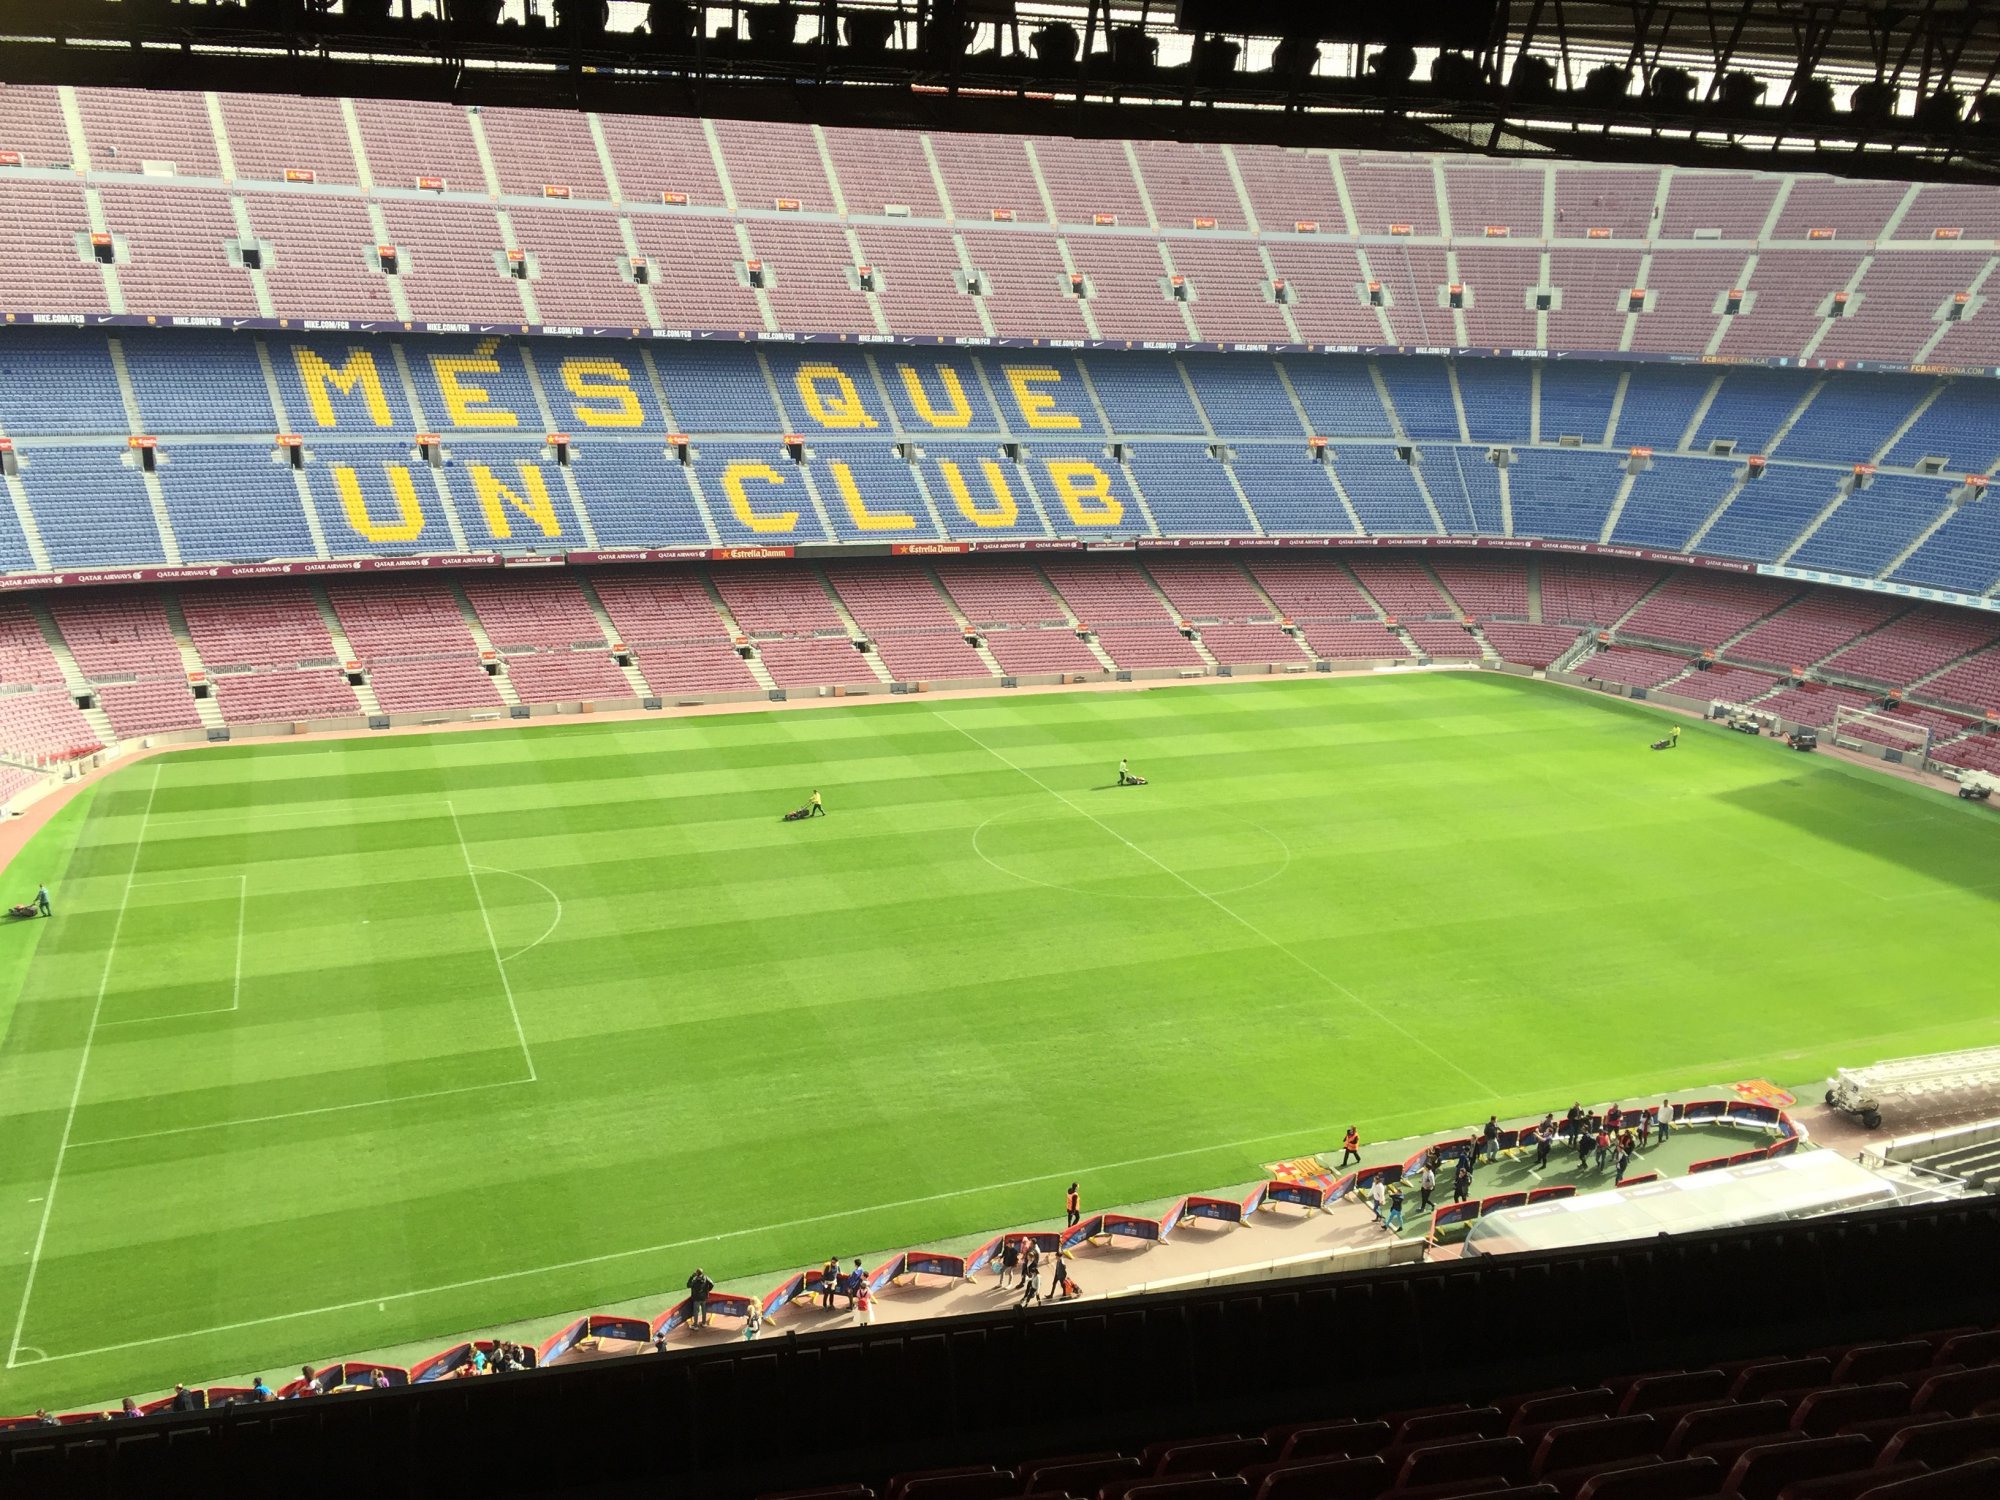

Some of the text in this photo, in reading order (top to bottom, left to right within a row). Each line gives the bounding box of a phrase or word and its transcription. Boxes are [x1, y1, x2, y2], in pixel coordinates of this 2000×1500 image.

[33, 314, 85, 324] NIKE.COM/FCB
[173, 316, 221, 326] NIKE.COM/FCB
[304, 320, 349, 330] NIKE.COM/FCB
[427, 323, 470, 332] NIKE.COM/FCB
[543, 326, 583, 335] NIKE.COM/FCB
[653, 329, 692, 338] NIKE.COM/FCB
[1910, 364, 1985, 375] FCBARCELONA.COM
[292, 338, 1081, 428] MÉS QUE
[331, 457, 1124, 541] UN CLUB
[908, 544, 960, 553] Estrella Damm
[731, 549, 786, 558] Estrella Damm
[304, 562, 353, 572] QATAR AIRWAYS
[374, 560, 395, 568] QATAR
[102, 572, 132, 580] AIRWAYS
[180, 568, 209, 576] AIRWAYS
